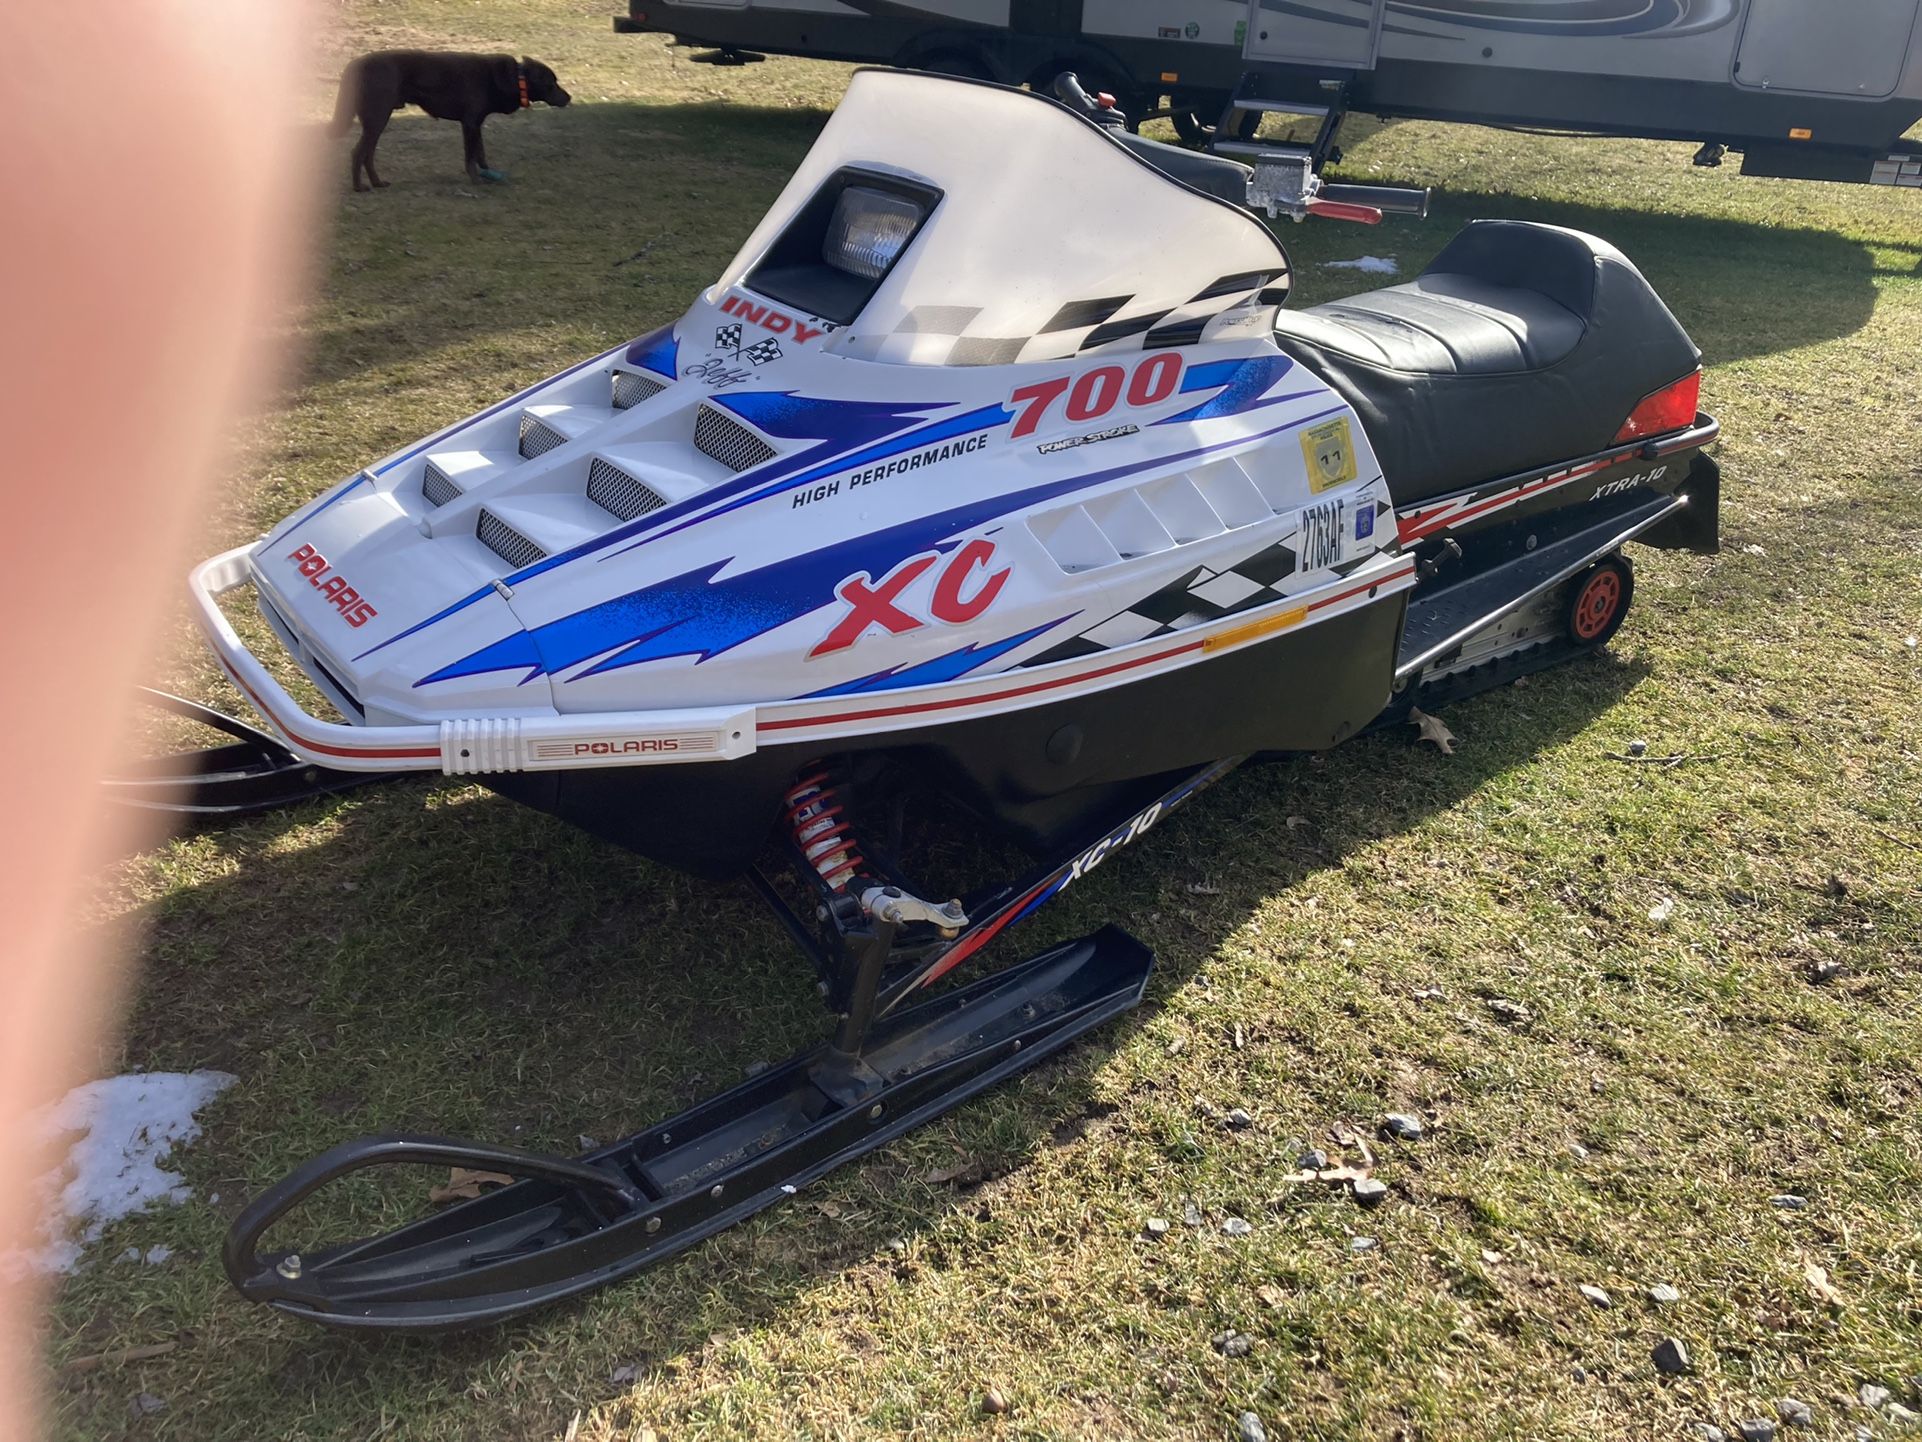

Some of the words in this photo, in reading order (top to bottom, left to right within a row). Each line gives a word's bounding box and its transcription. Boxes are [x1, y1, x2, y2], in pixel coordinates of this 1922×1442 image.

[720, 296, 823, 345] INDY
[1010, 352, 1184, 440] 700
[792, 480, 840, 509] HIGH
[849, 434, 988, 490] PERFORMANCE
[1039, 437, 1085, 454] POWER
[1086, 424, 1139, 445] STROKE
[1589, 465, 1668, 502] XTRA-10
[1302, 498, 1345, 573] 2763AF
[286, 541, 379, 628] POLARIS
[808, 538, 1012, 658] XC
[574, 738, 679, 755] POLARIS
[1057, 802, 1163, 892] XC-10
